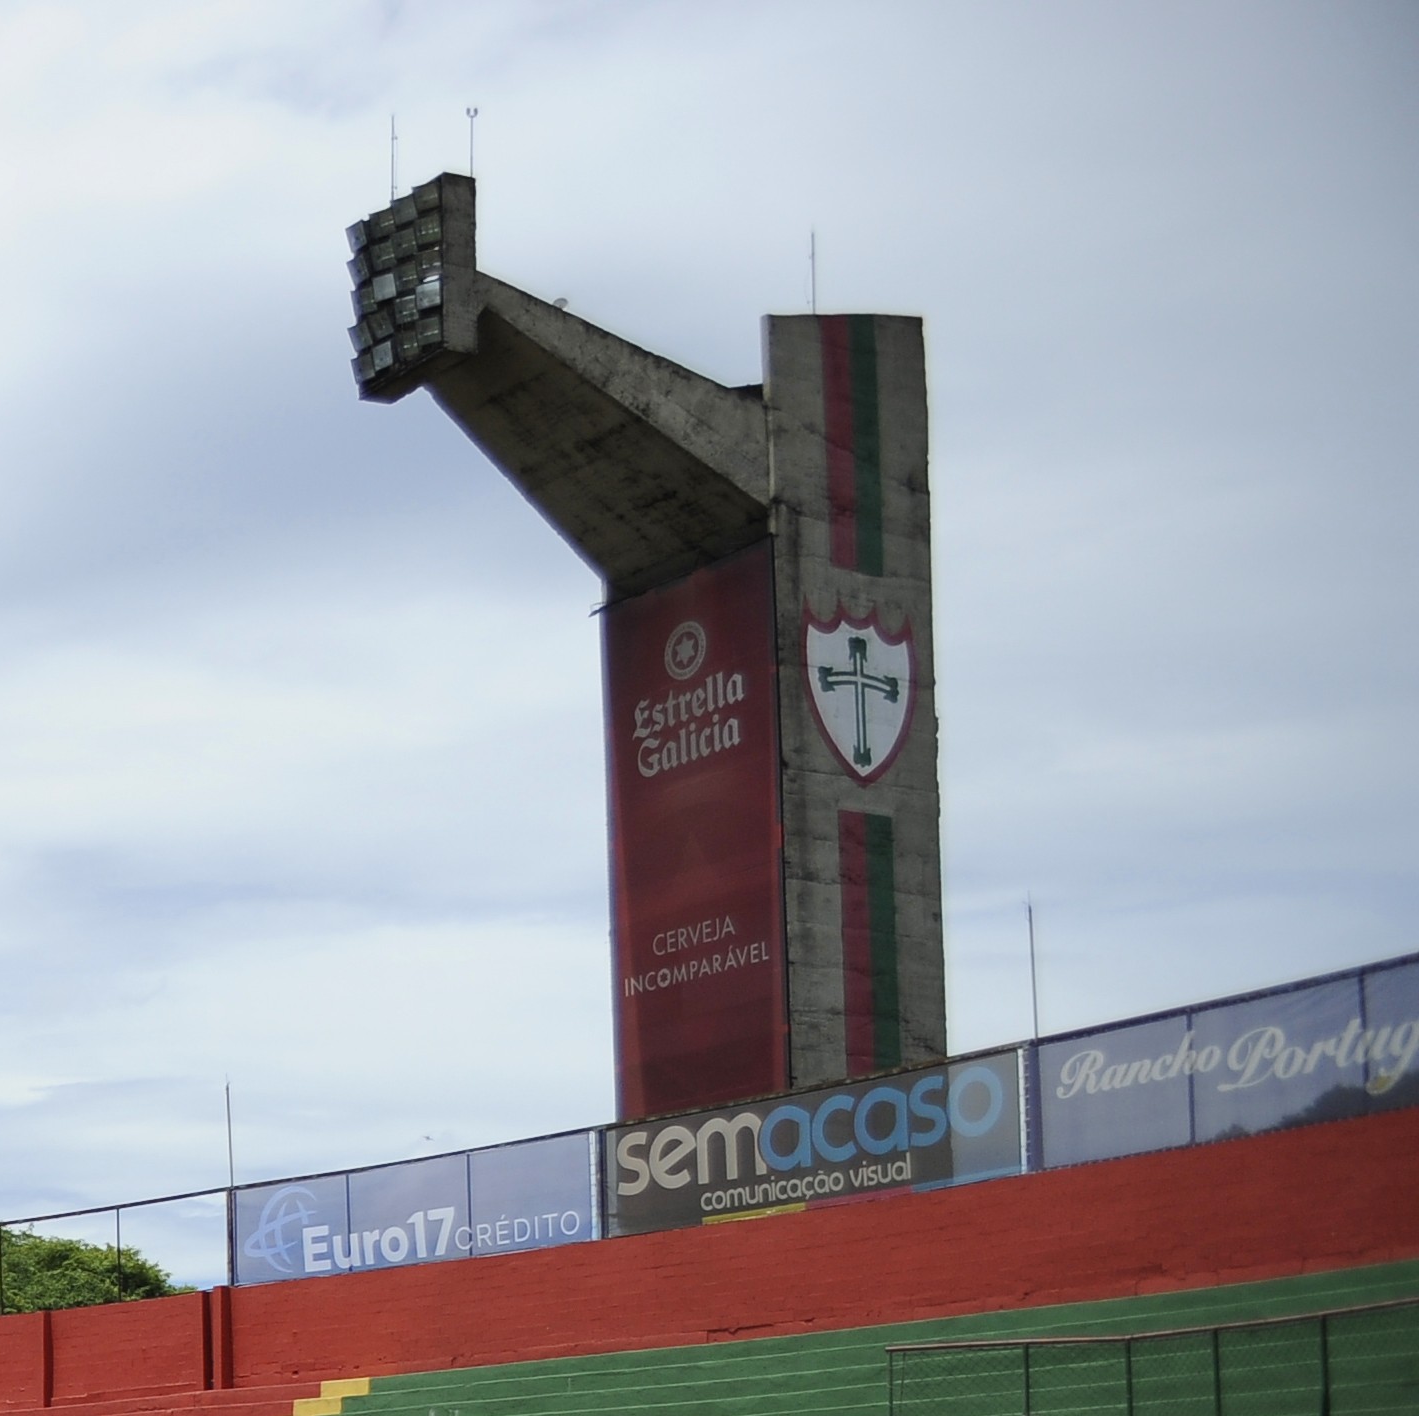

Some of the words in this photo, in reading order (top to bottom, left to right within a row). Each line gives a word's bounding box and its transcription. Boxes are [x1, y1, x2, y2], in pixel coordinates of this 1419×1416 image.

[632, 671, 745, 741] Estrella
[637, 716, 741, 777] Galicia
[653, 915, 735, 956] CERVEJA
[624, 941, 769, 997] INCOMPARÁVEL
[1056, 1031, 1221, 1099] Rancho
[701, 1170, 843, 1212] comunicação
[850, 1152, 911, 1188] visual
[302, 1207, 454, 1273] Euro17
[455, 1210, 580, 1251] CRÉDITO
